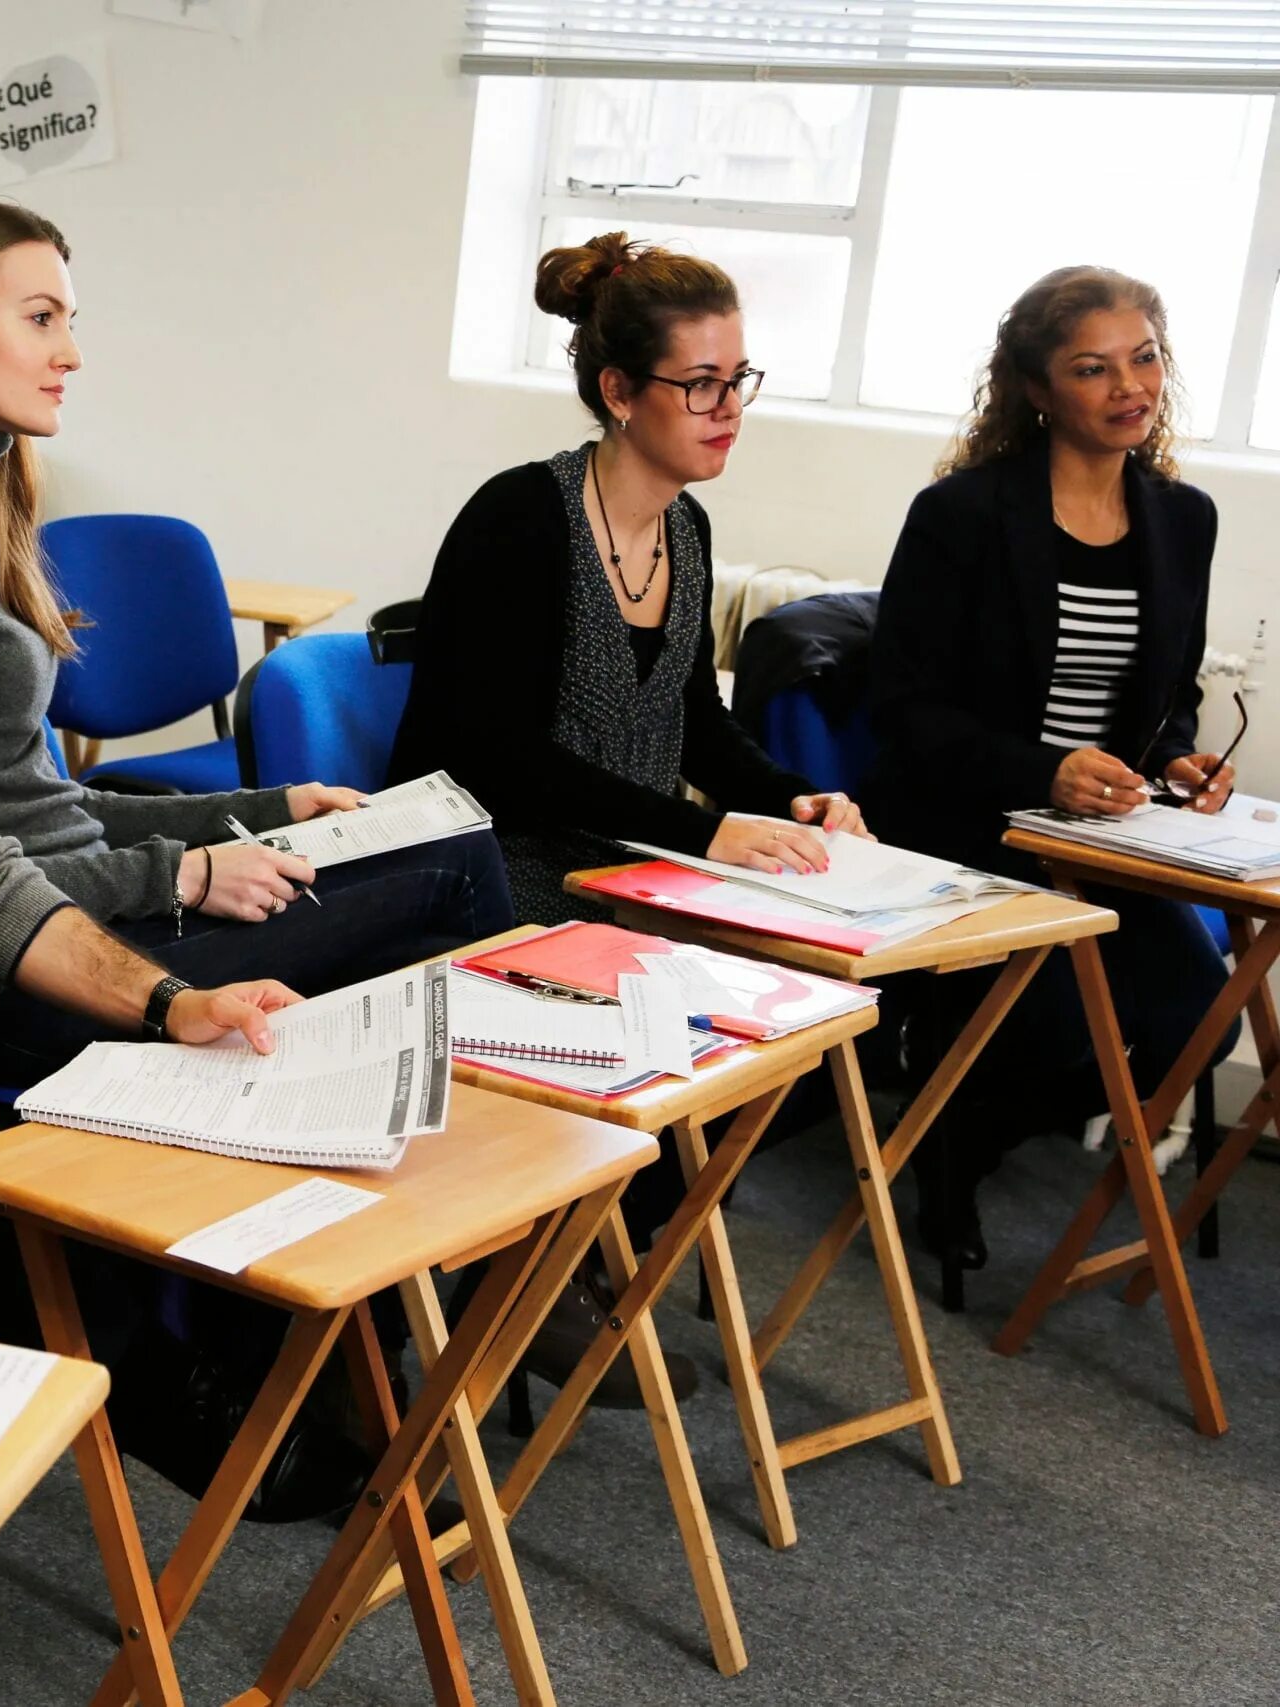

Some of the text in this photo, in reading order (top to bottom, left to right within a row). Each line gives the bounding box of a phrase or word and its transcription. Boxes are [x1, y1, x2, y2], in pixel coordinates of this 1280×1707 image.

[0, 104, 97, 151] significa?
[433, 981, 444, 1060] DANGEROUS GAMES
